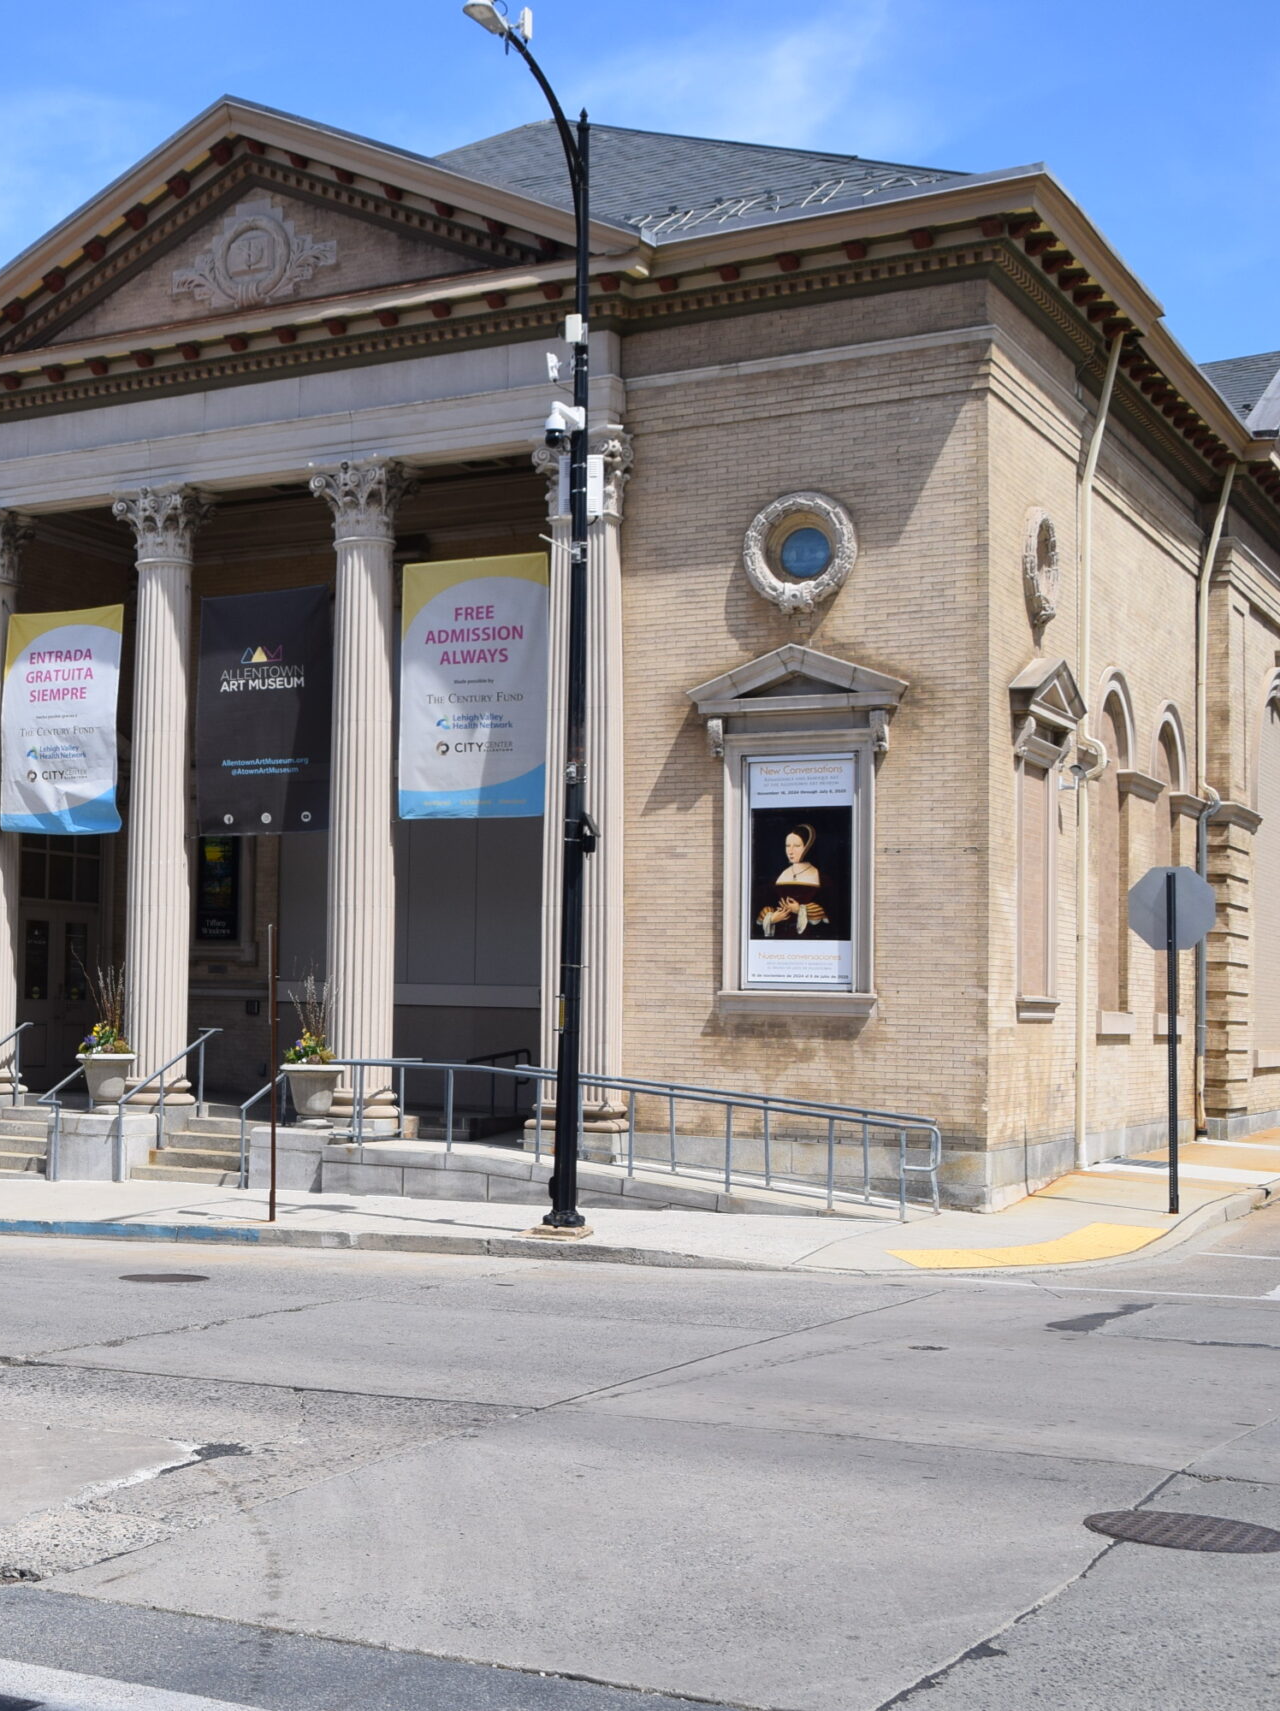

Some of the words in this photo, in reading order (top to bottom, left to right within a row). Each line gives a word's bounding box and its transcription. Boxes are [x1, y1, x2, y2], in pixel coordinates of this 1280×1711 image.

[454, 605, 495, 622] FREE
[425, 625, 524, 645] ADMISSION
[29, 648, 93, 665] ENTRADA
[440, 648, 509, 665] ALWAYS
[26, 667, 94, 684] GRATUITA
[220, 664, 305, 681] ALLENTOWN
[220, 680, 246, 692] ART
[249, 677, 305, 690] MUSEUM
[29, 687, 87, 703] SIEMPRE
[452, 714, 480, 723] Lehigh
[480, 713, 504, 722] Valley
[452, 722, 479, 730] Health
[479, 720, 513, 730] Network
[39, 745, 60, 754] Lehigh
[60, 744, 80, 753] Valley
[39, 751, 60, 760] Health
[61, 750, 87, 759] Network
[221, 757, 310, 767] AllentownArtMuseum.org
[760, 767, 780, 776] New
[783, 764, 844, 775] Conversations
[758, 952, 785, 960] Nuevas
[786, 953, 842, 961] conversaciones
